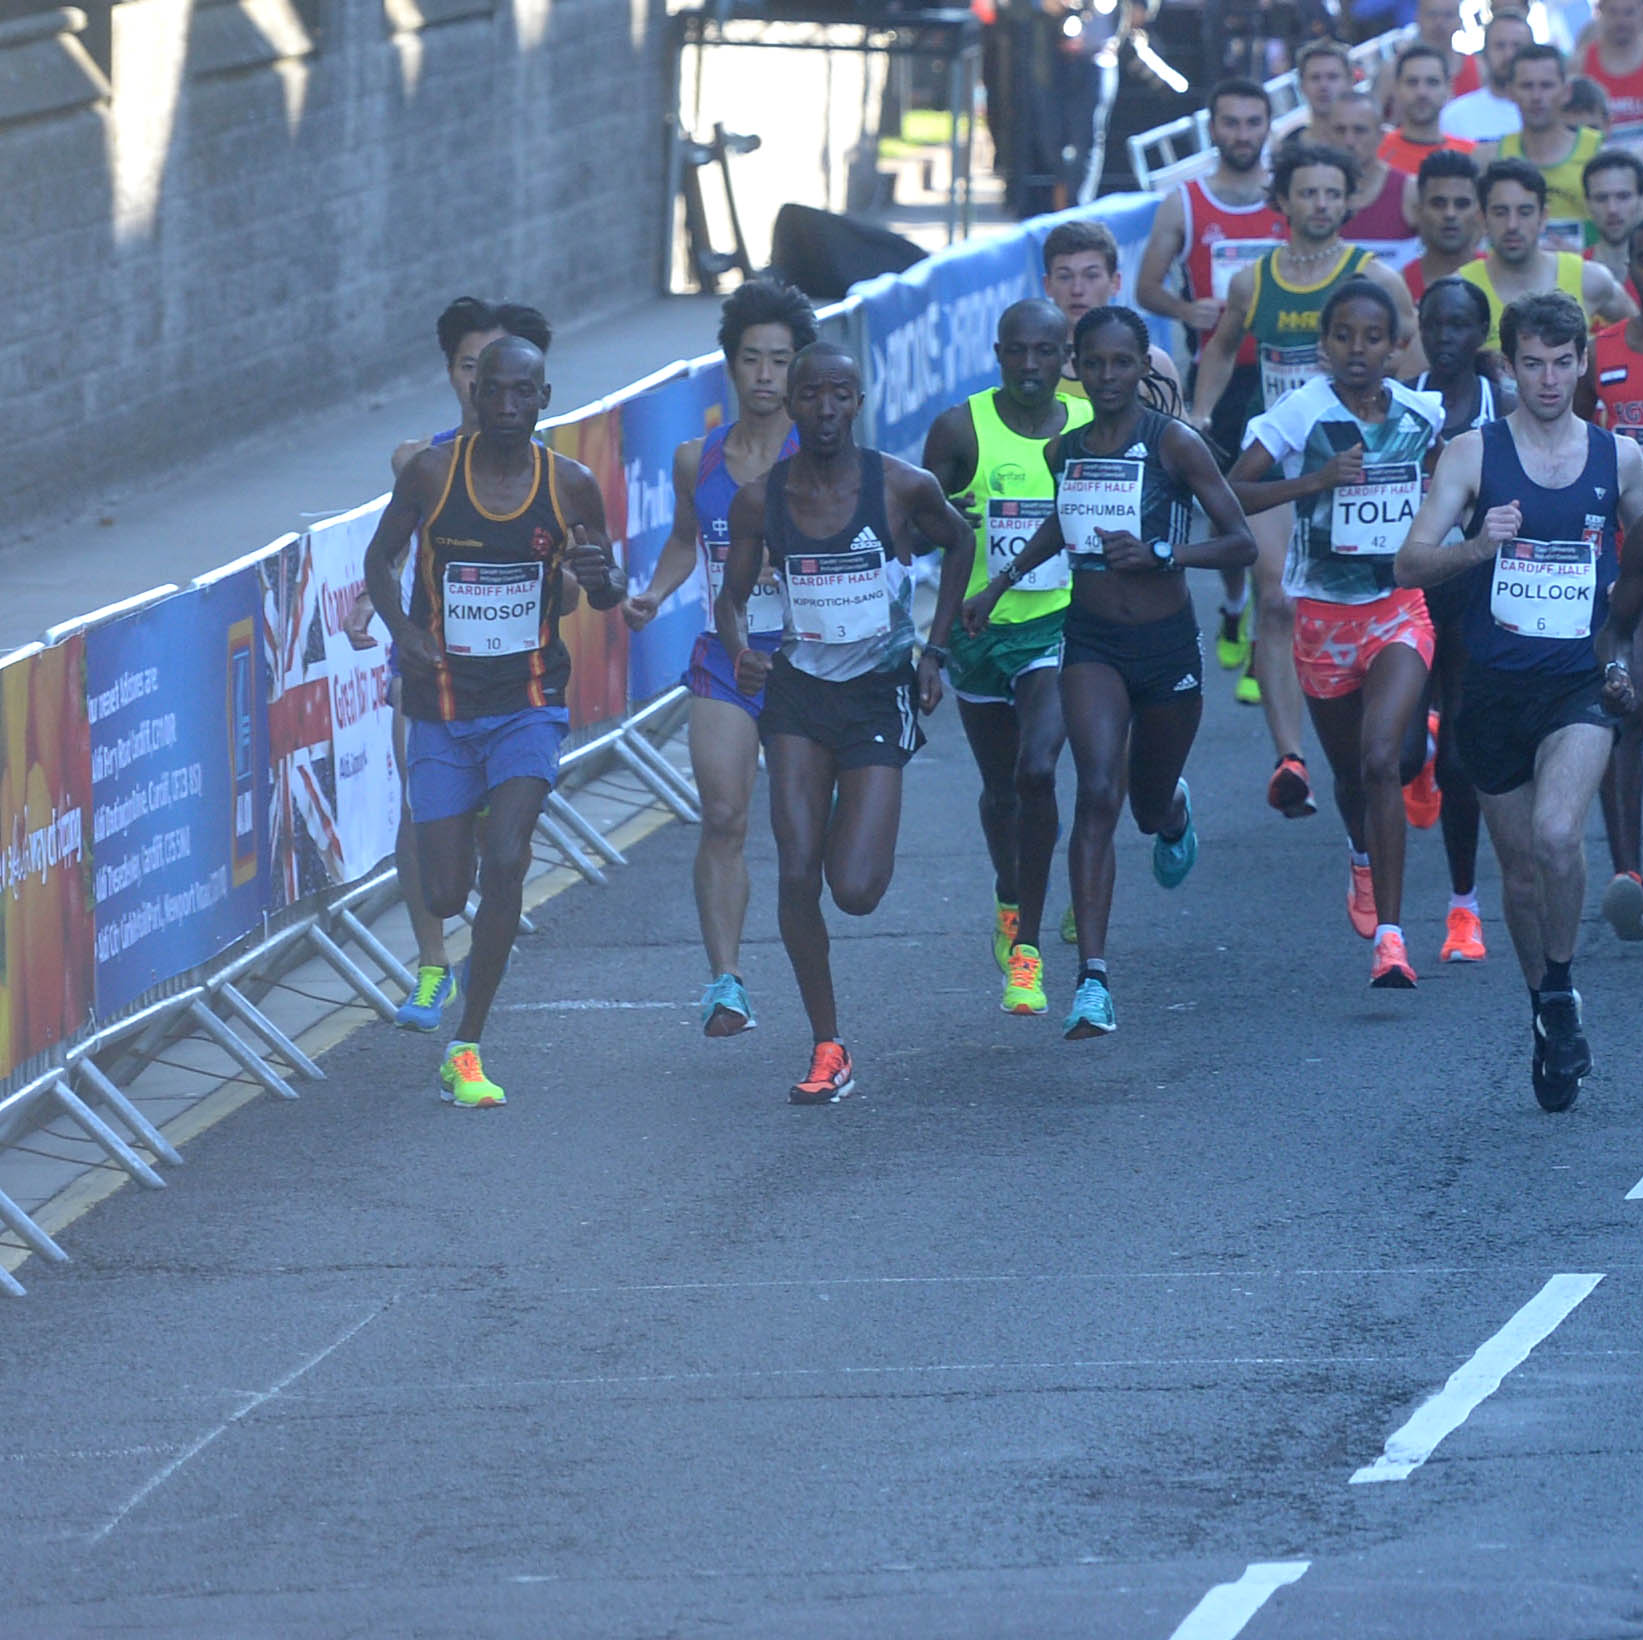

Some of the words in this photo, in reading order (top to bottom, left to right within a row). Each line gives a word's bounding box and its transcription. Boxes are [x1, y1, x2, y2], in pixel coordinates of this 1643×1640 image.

[1062, 481, 1101, 493] CARDIFF
[1104, 481, 1137, 492] HALF
[1060, 503, 1136, 517] JEPCHUMBA
[1338, 498, 1414, 526] TOLA
[1371, 535, 1387, 549] 42
[1500, 560, 1554, 574] CARDIFF
[1558, 564, 1591, 576] HALF
[791, 573, 844, 587] CARDIFF
[848, 571, 880, 585] HALF
[449, 583, 502, 597] CARDIFF
[506, 581, 537, 596] HALF
[1496, 581, 1591, 601] POLLOCK
[793, 589, 884, 609] KIPROTICH-SANG
[448, 601, 537, 621] KIMOSOP
[837, 625, 847, 638] 3
[1536, 617, 1546, 631] 6
[486, 637, 501, 650] 10
